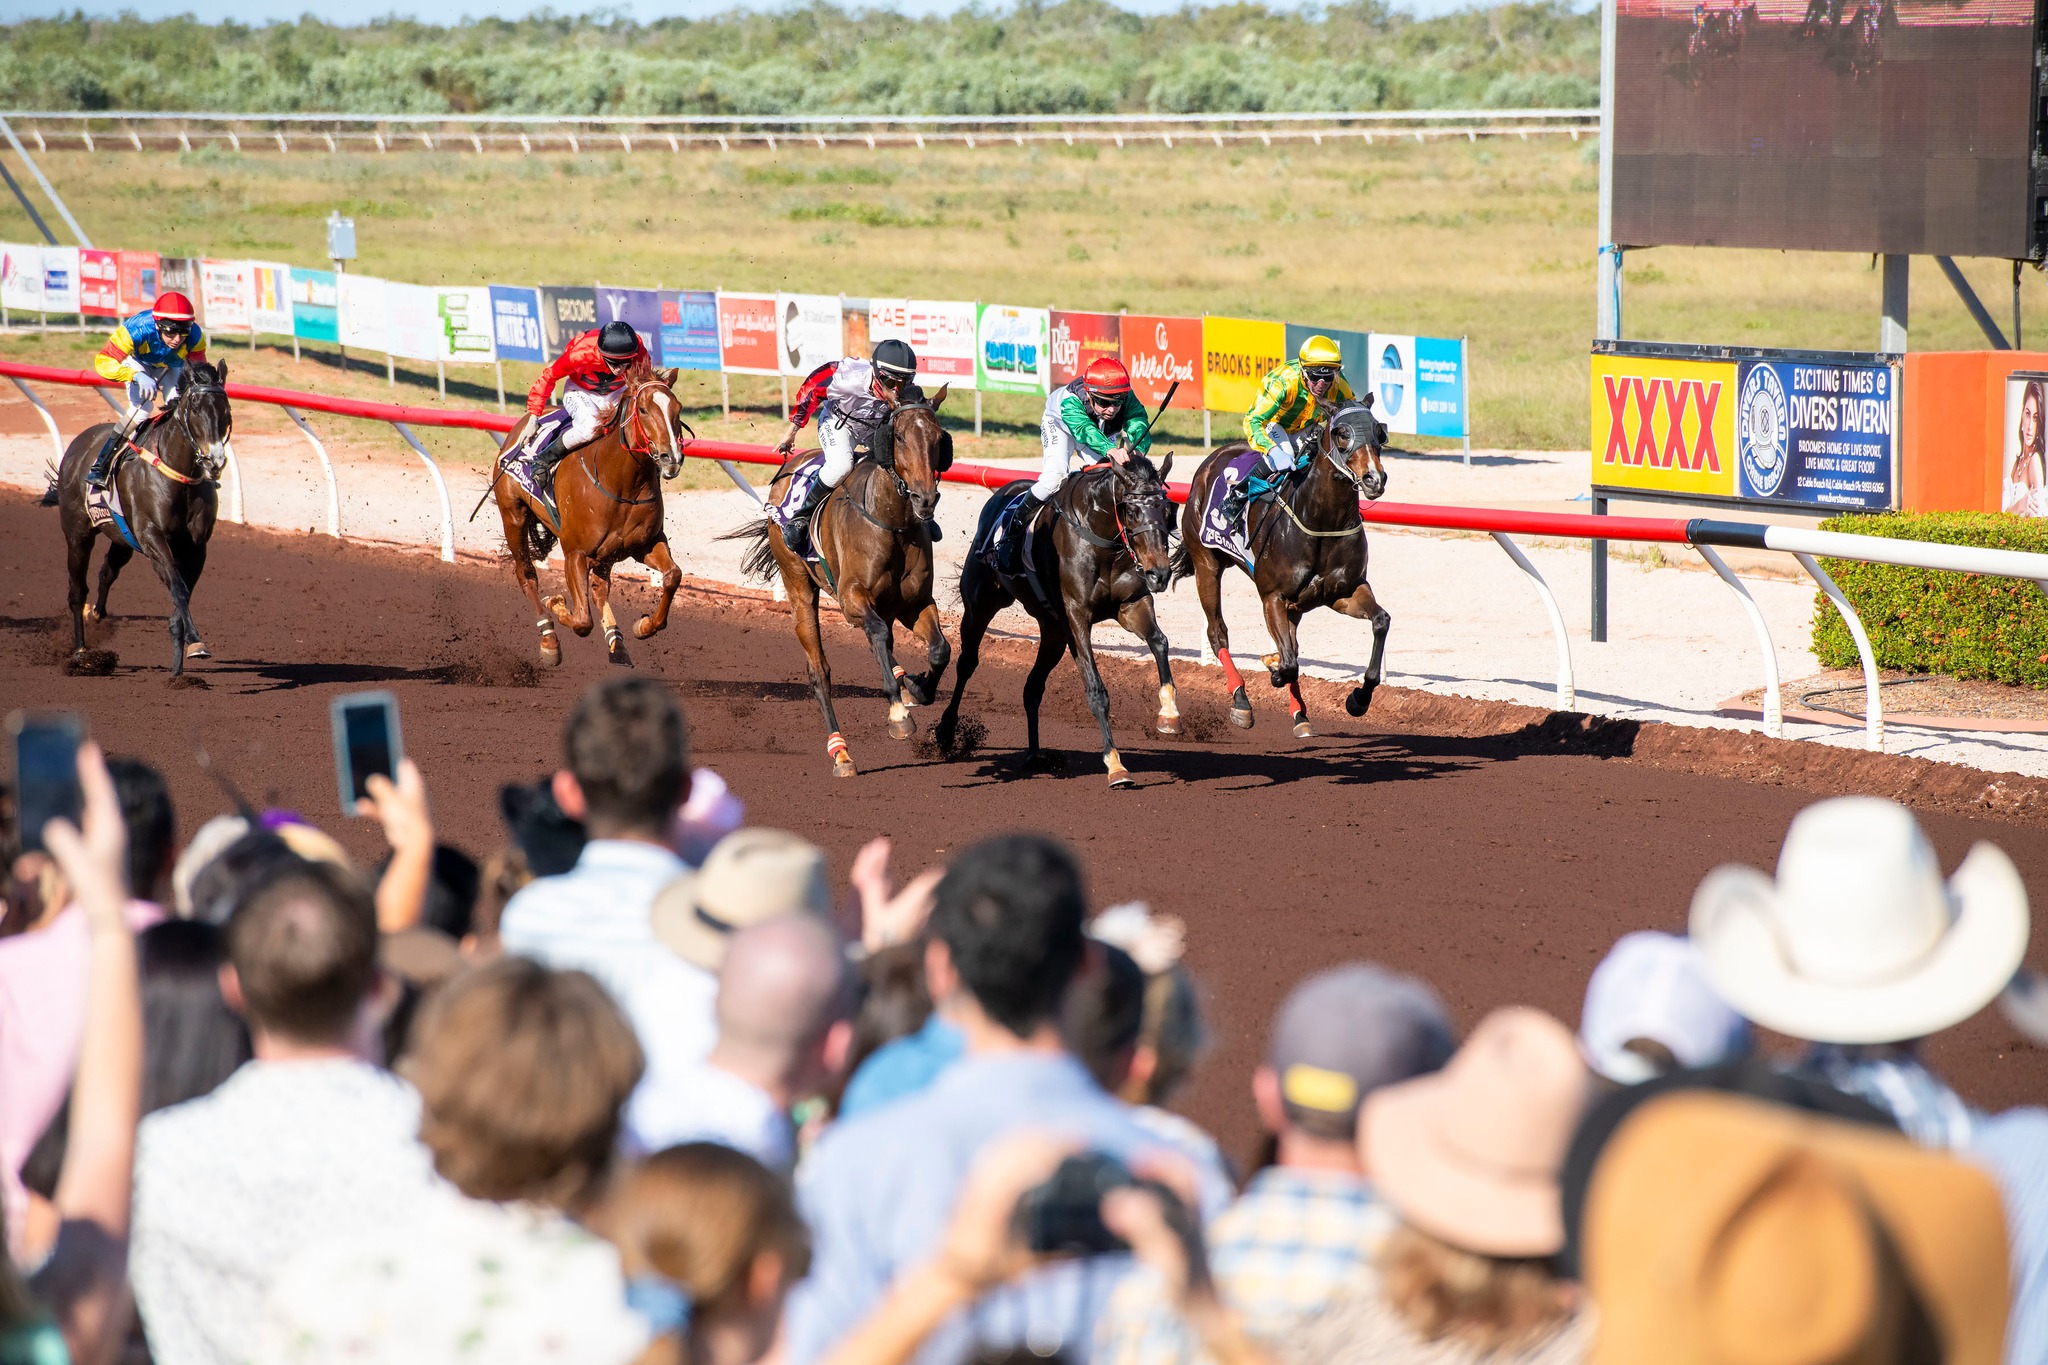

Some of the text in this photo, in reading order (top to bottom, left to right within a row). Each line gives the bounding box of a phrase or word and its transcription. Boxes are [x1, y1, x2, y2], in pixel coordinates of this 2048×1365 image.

[558, 298, 596, 322] BROOME
[661, 301, 682, 325] BK
[871, 308, 905, 326] KAS
[1051, 328, 1080, 376] Roey
[1207, 351, 1251, 377] BROOKS
[1131, 351, 1163, 386] Willie
[1163, 353, 1194, 382] Creek
[1794, 368, 1886, 395] EXCITING TIMES @
[1741, 369, 1786, 441] DIVERS TAVERN
[1790, 394, 1891, 435] DIVERS TAVERN
[1602, 375, 1723, 474] XXXX
[1798, 440, 1826, 454] BROOME'S
[1826, 442, 1843, 455] HOME
[1842, 443, 1850, 455] OF
[1850, 444, 1862, 456] LIVE
[1805, 457, 1876, 474] LIVE MUSIC & GREAT FOOD!
[1803, 476, 1814, 488] Cable
[1813, 478, 1826, 489] Beach
[1832, 479, 1843, 490] Cable
[1843, 480, 1855, 492] Beach
[1205, 526, 1240, 556] TABtou
